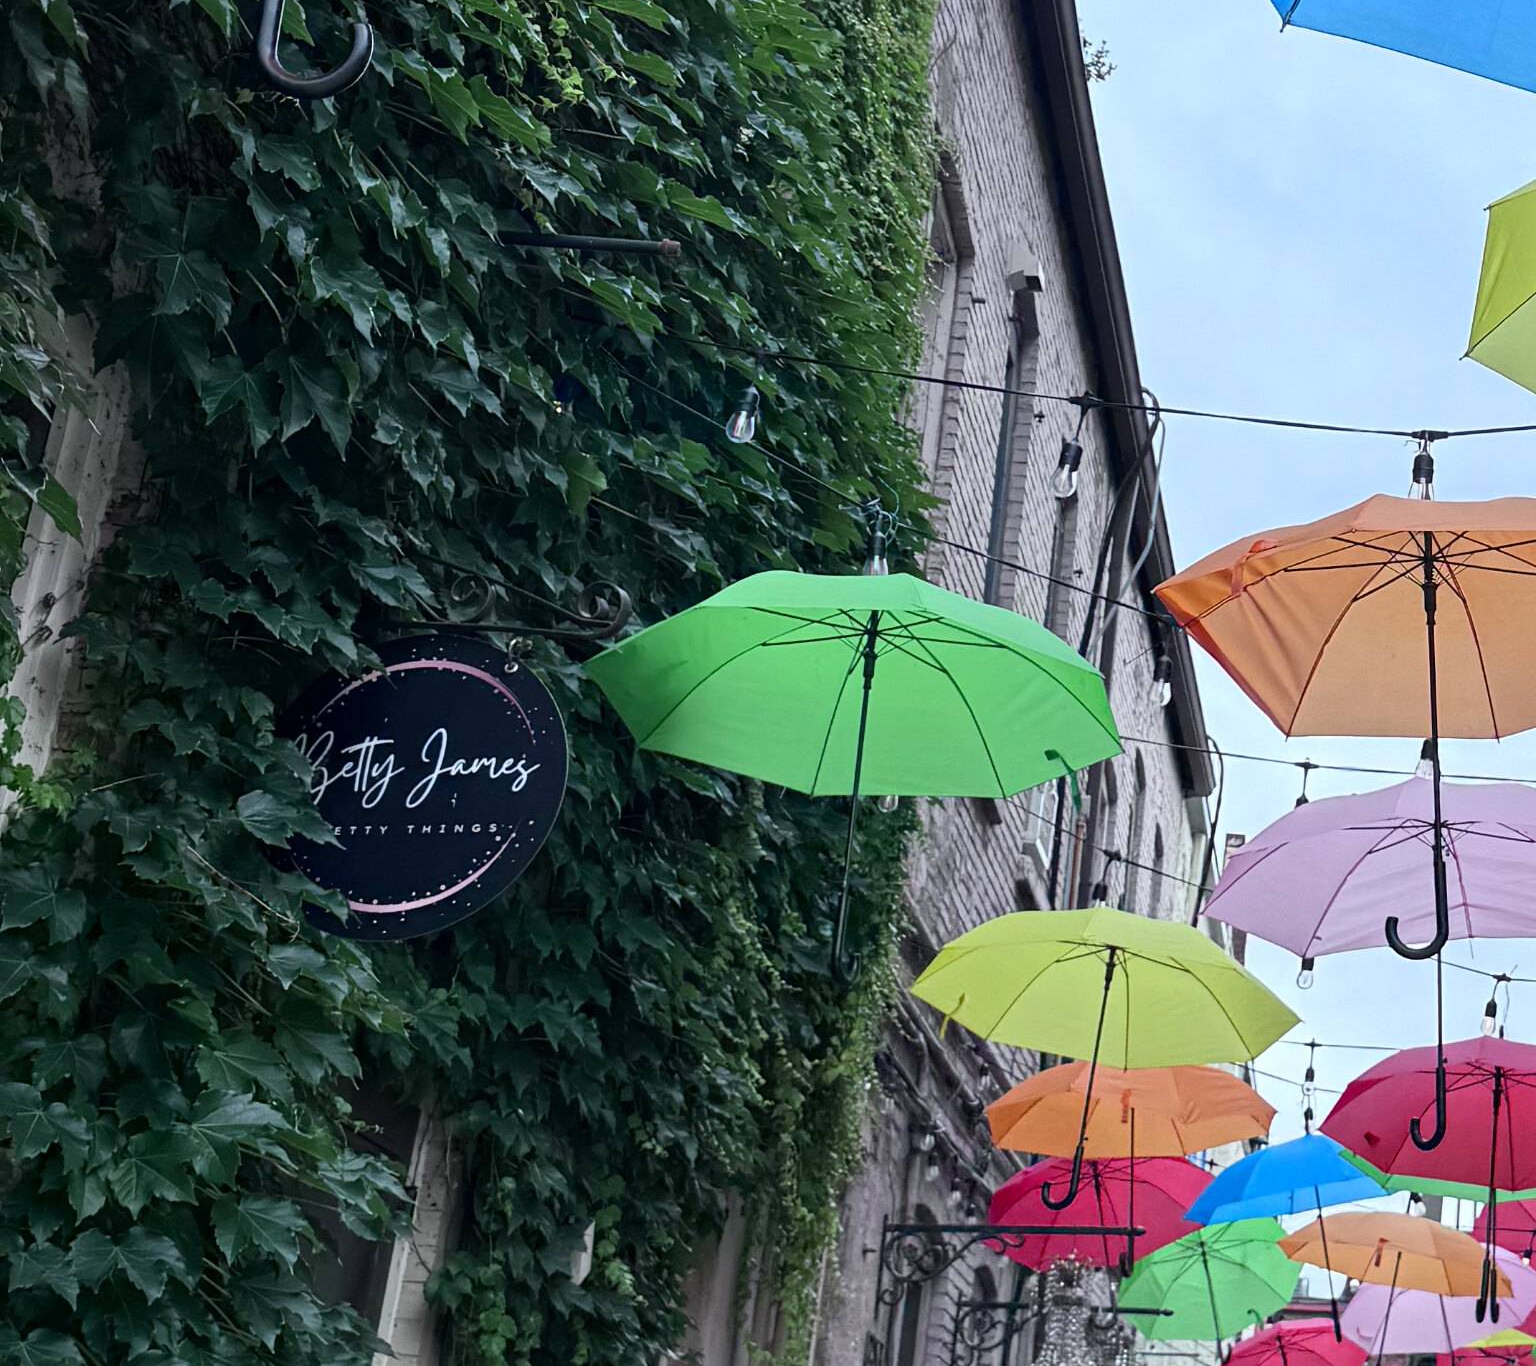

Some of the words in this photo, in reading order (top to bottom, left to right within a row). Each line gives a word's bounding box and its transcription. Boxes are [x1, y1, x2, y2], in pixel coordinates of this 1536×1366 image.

[294, 731, 405, 809] Betty
[406, 727, 540, 809] James
[334, 826, 389, 836] ETTY
[407, 823, 498, 834] THINGS
